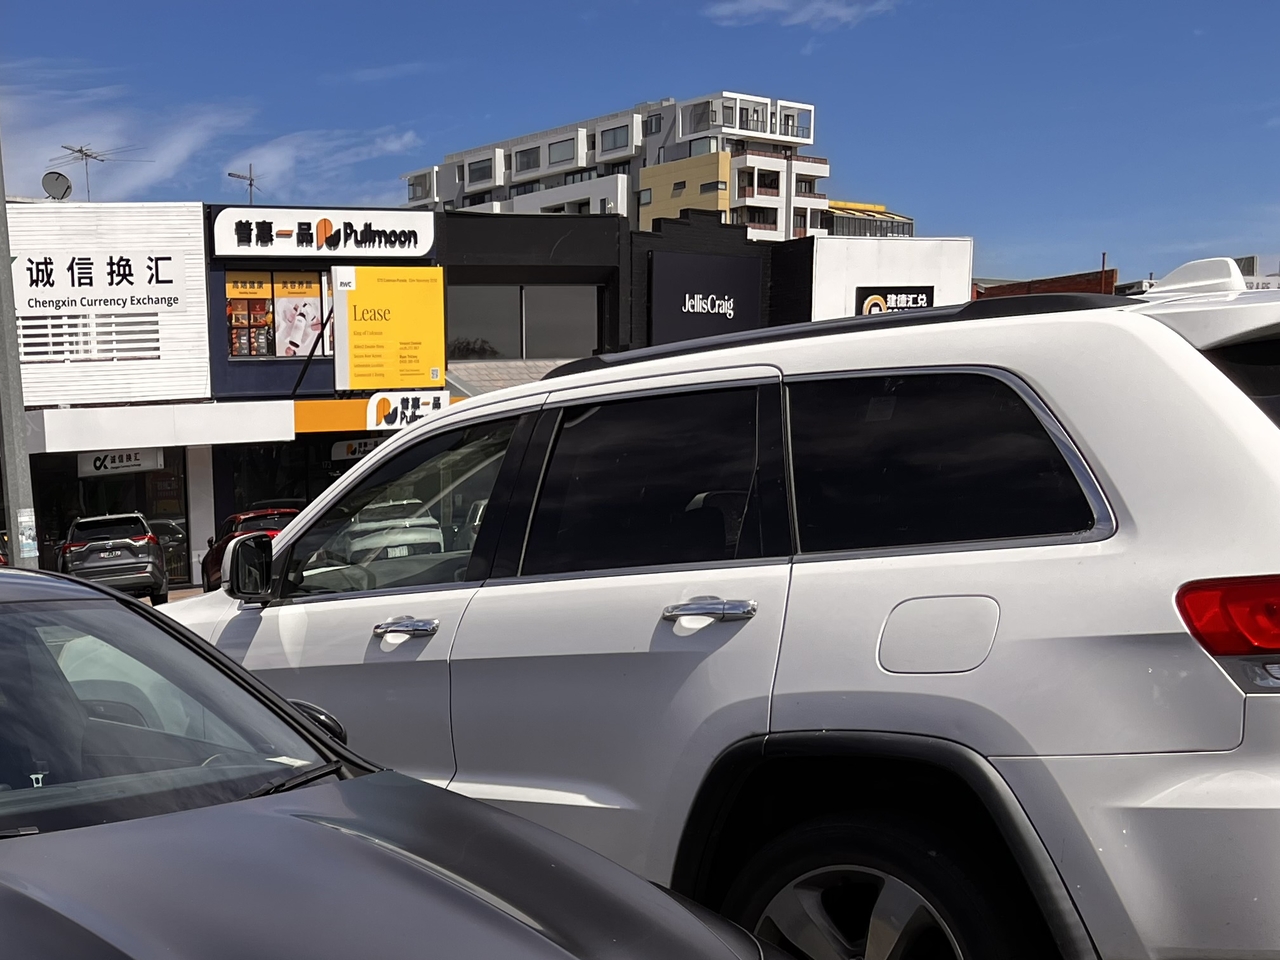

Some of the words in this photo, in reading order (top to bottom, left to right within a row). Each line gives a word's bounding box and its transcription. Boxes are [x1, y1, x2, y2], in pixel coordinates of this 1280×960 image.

[343, 221, 419, 249] Pullmoon
[26, 256, 174, 288] 诚信换汇
[27, 298, 77, 311] Chengxin
[80, 297, 127, 309] Currency
[130, 294, 179, 308] Exchange
[353, 305, 392, 322] Lease
